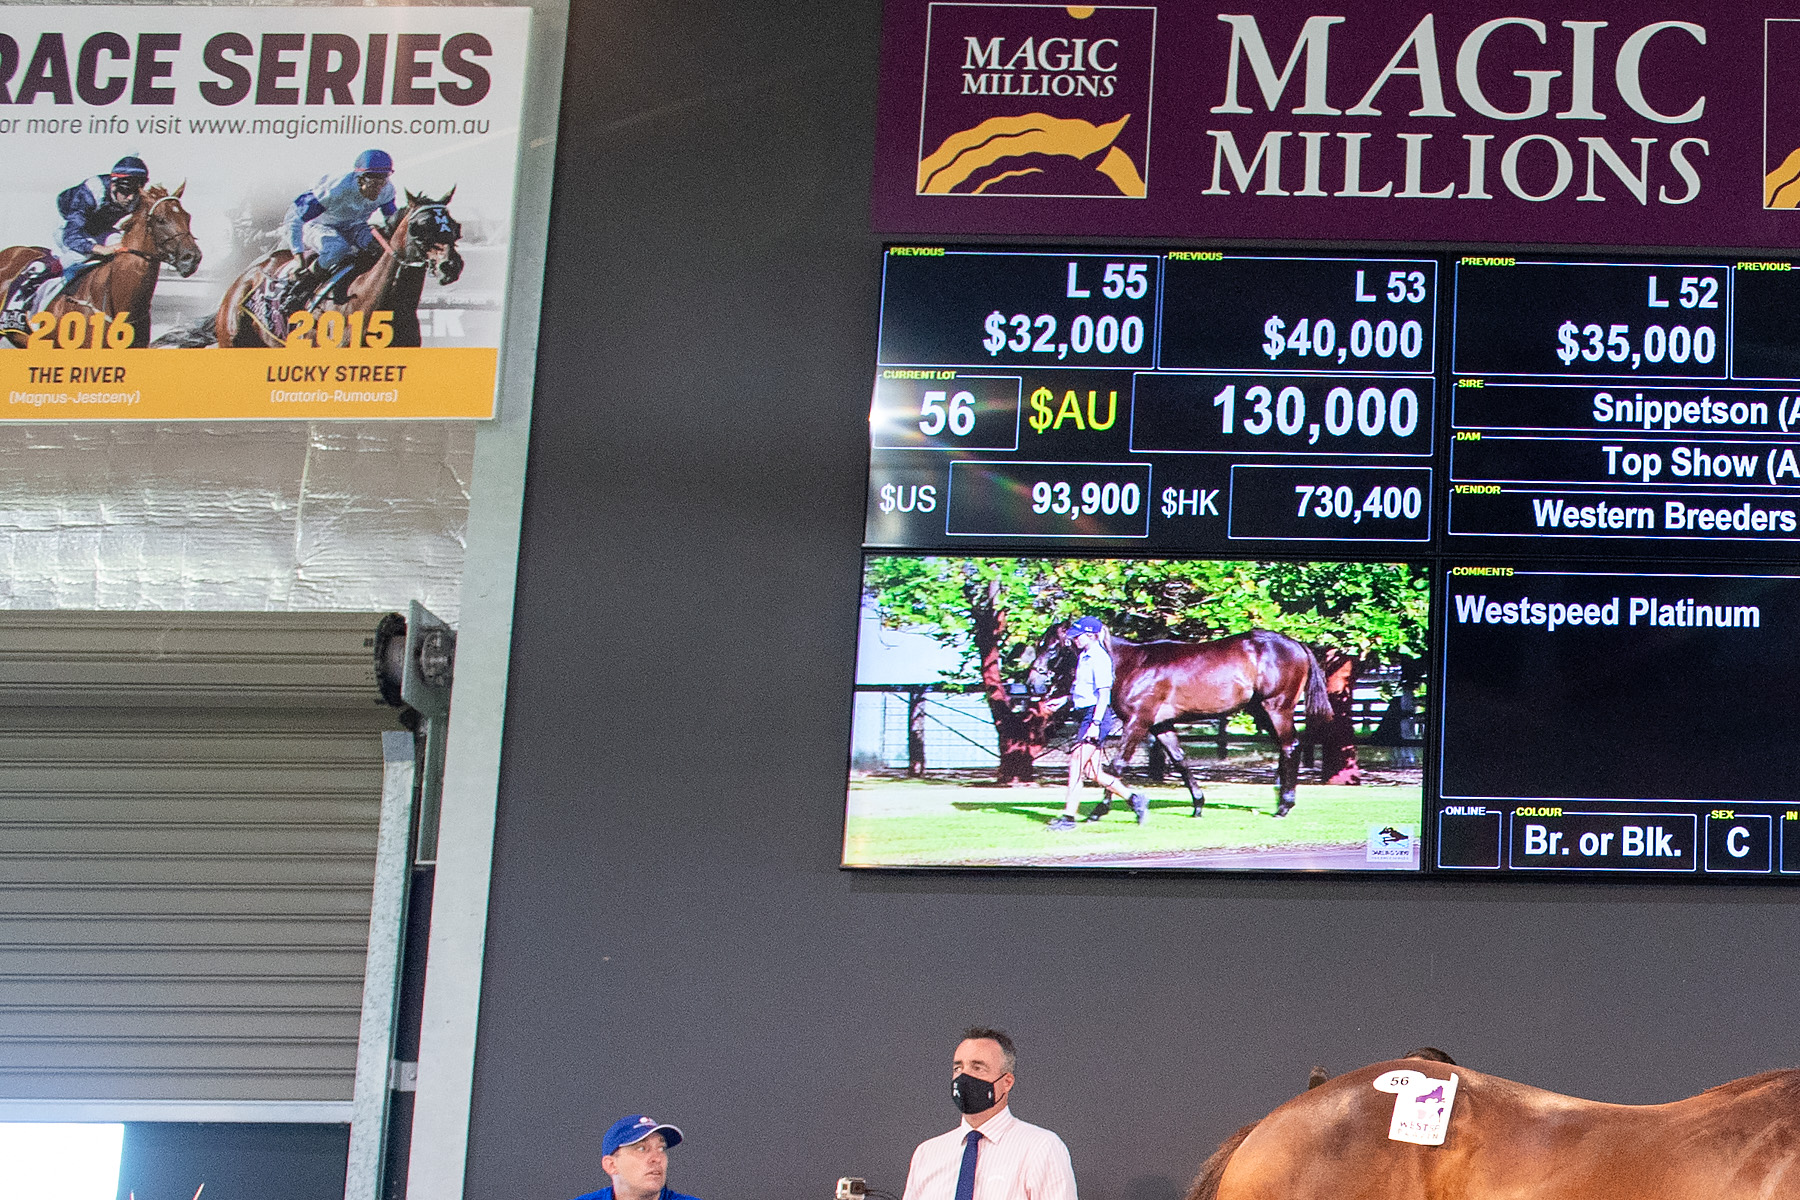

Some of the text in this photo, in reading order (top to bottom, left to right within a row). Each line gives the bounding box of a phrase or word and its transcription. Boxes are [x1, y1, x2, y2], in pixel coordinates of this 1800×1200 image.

[199, 32, 492, 106] SERIES
[961, 37, 1118, 72] MAGIC
[1210, 13, 1706, 123] MAGIC
[961, 73, 1116, 97] MILLIONS
[27, 119, 82, 134] more
[89, 115, 129, 134] info
[137, 115, 181, 134] visit
[189, 115, 489, 139] www.magicmillions.com.au
[1202, 130, 1709, 205] MILLIONS
[889, 246, 945, 256] PREVIOUS
[1168, 251, 1223, 260] PREVIOUS
[1461, 256, 1516, 266] PREVIOUS
[1737, 261, 1792, 271] PREVIOUS
[1066, 262, 1148, 299] L 55
[1355, 270, 1426, 303] L 53
[1648, 275, 1719, 309] L 52
[28, 311, 135, 349] 2016
[287, 310, 395, 349] 2015
[982, 310, 1144, 360] $32,000
[1262, 315, 1423, 364] $40,000
[1556, 320, 1716, 370] $35,000
[29, 367, 125, 383] THE RIVER
[267, 366, 406, 382] LUCKY STREET
[883, 369, 956, 379] CURRENT LOT
[1458, 378, 1483, 389] SIRE
[918, 390, 976, 437] 56
[1028, 386, 1118, 434] $AU
[1213, 385, 1418, 445] 130,000
[1592, 392, 1768, 430] Snippetson
[1456, 431, 1481, 441] DAM
[1602, 445, 1662, 483] Top
[1670, 446, 1759, 477] Show
[879, 484, 937, 514] $US
[1032, 481, 1141, 521] 93,900
[1161, 486, 1220, 519] $HK
[1295, 485, 1422, 524] 730,400
[1454, 484, 1501, 494] VENDOR
[1532, 499, 1655, 529] Western
[1665, 501, 1797, 532] Breeders
[1452, 566, 1514, 577] COMMENTS
[1454, 594, 1760, 632] Westspeed Platinum
[1444, 806, 1486, 816] ONLINE
[1515, 806, 1563, 817] COLOUR
[1711, 809, 1735, 820] SEX
[1785, 810, 1799, 821] IN
[1525, 824, 1570, 855] Br.
[1622, 825, 1682, 857] Blk.
[1726, 826, 1750, 858] C
[1390, 1076, 1410, 1086] 56
